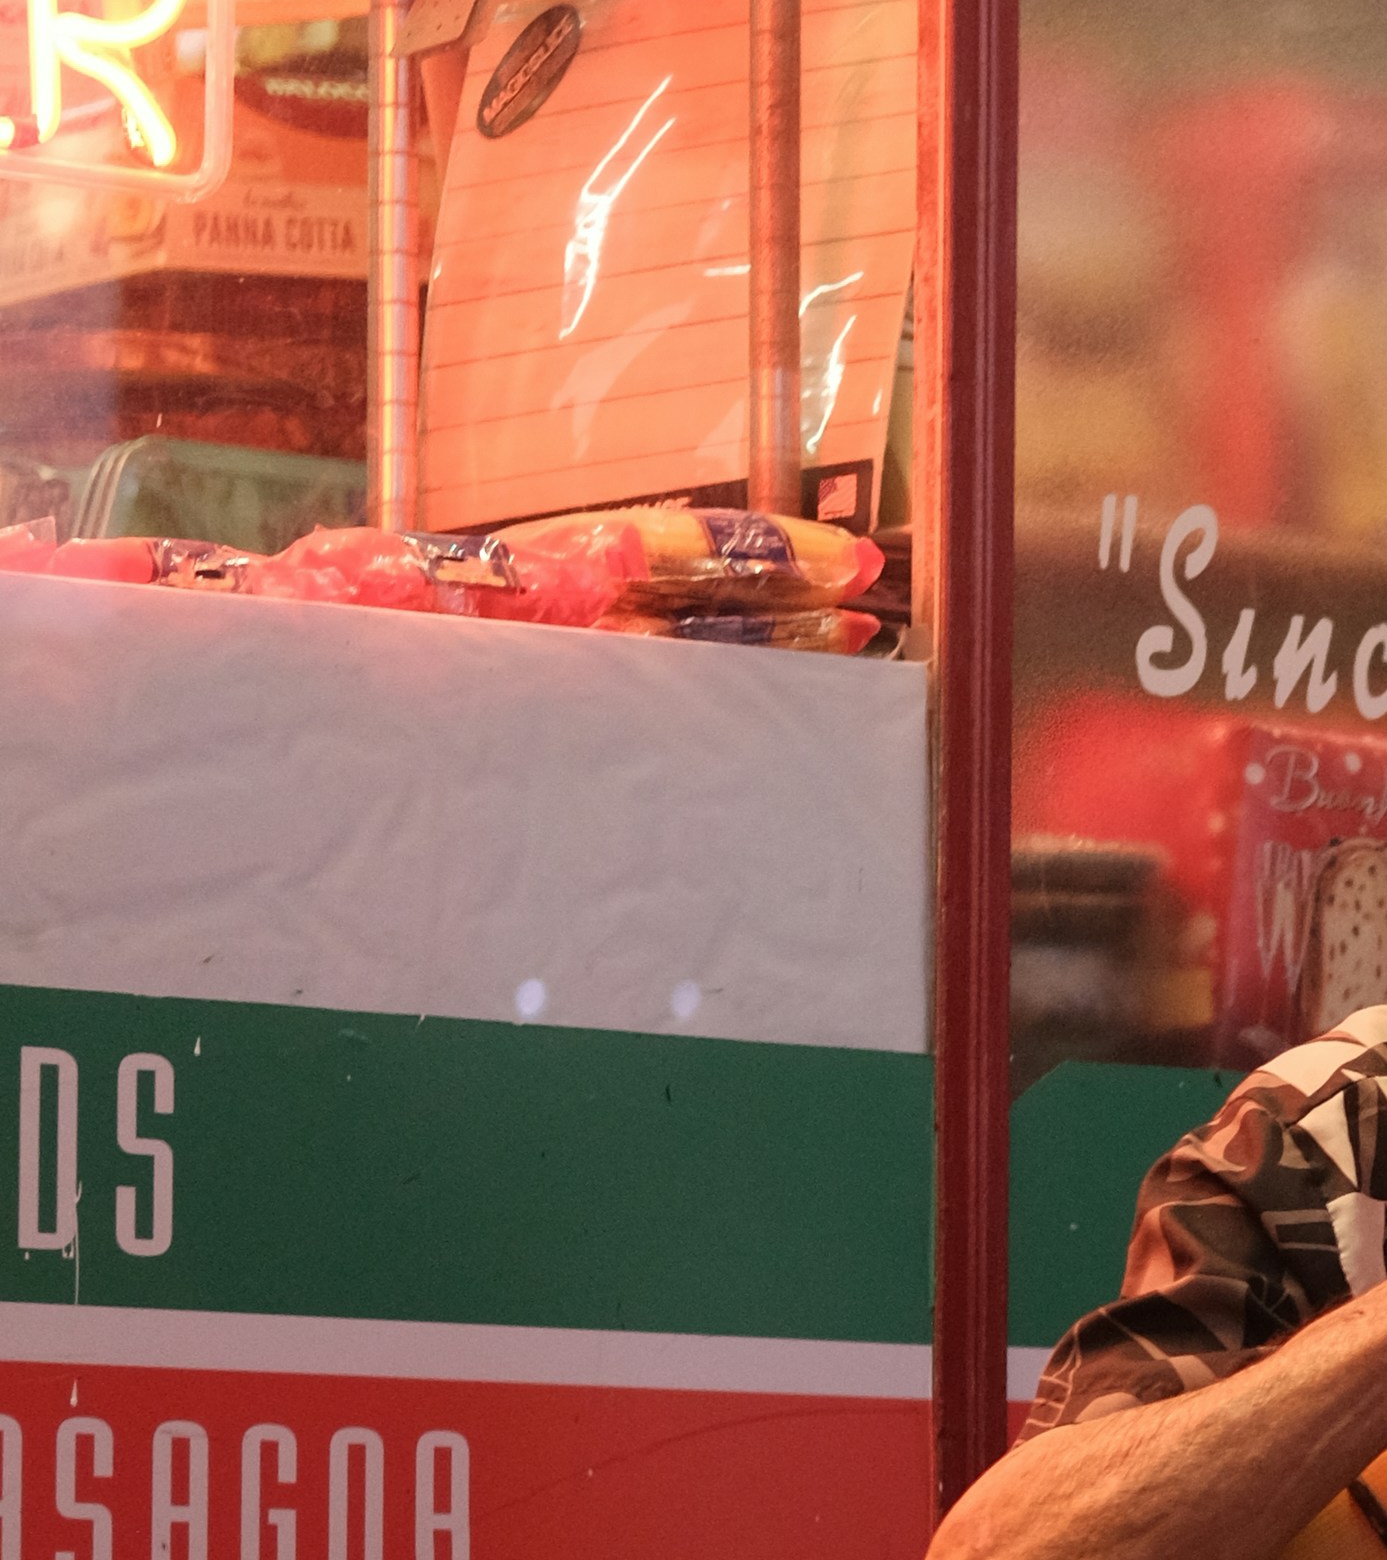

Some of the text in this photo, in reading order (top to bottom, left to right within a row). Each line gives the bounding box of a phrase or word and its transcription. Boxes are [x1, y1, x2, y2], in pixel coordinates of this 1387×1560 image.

[193, 211, 356, 255] PANNA COTTA
[18, 1045, 175, 1257] DS
